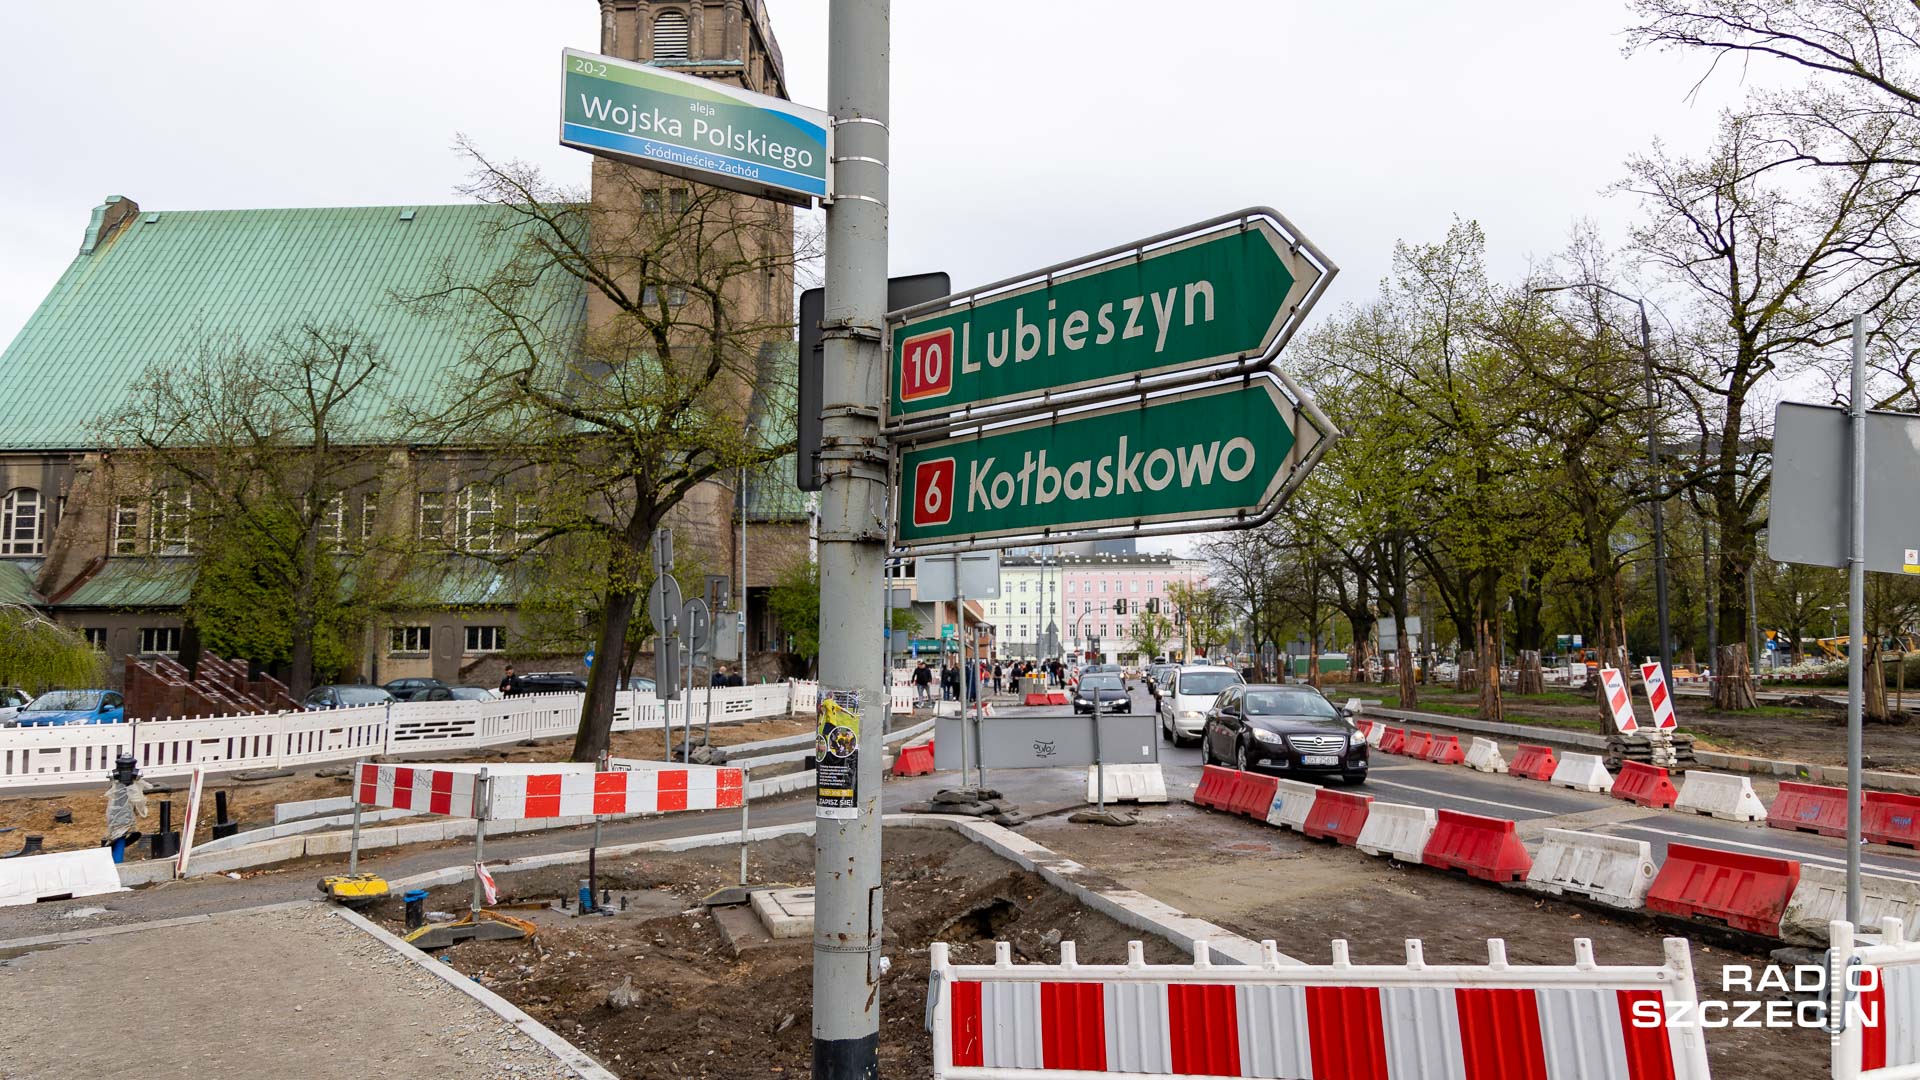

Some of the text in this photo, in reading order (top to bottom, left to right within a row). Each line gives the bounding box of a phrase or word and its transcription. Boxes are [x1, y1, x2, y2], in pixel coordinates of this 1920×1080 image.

[575, 59, 607, 77] 20-2
[690, 102, 715, 116] aleja
[581, 94, 813, 169] Wojska Polskiego
[644, 142, 759, 179] Śródmieście-Zachód
[911, 280, 1215, 388] 10 Lubieszyn
[924, 435, 1256, 514] 6 Kołbaskowo
[820, 798, 838, 806] ZAPISZ
